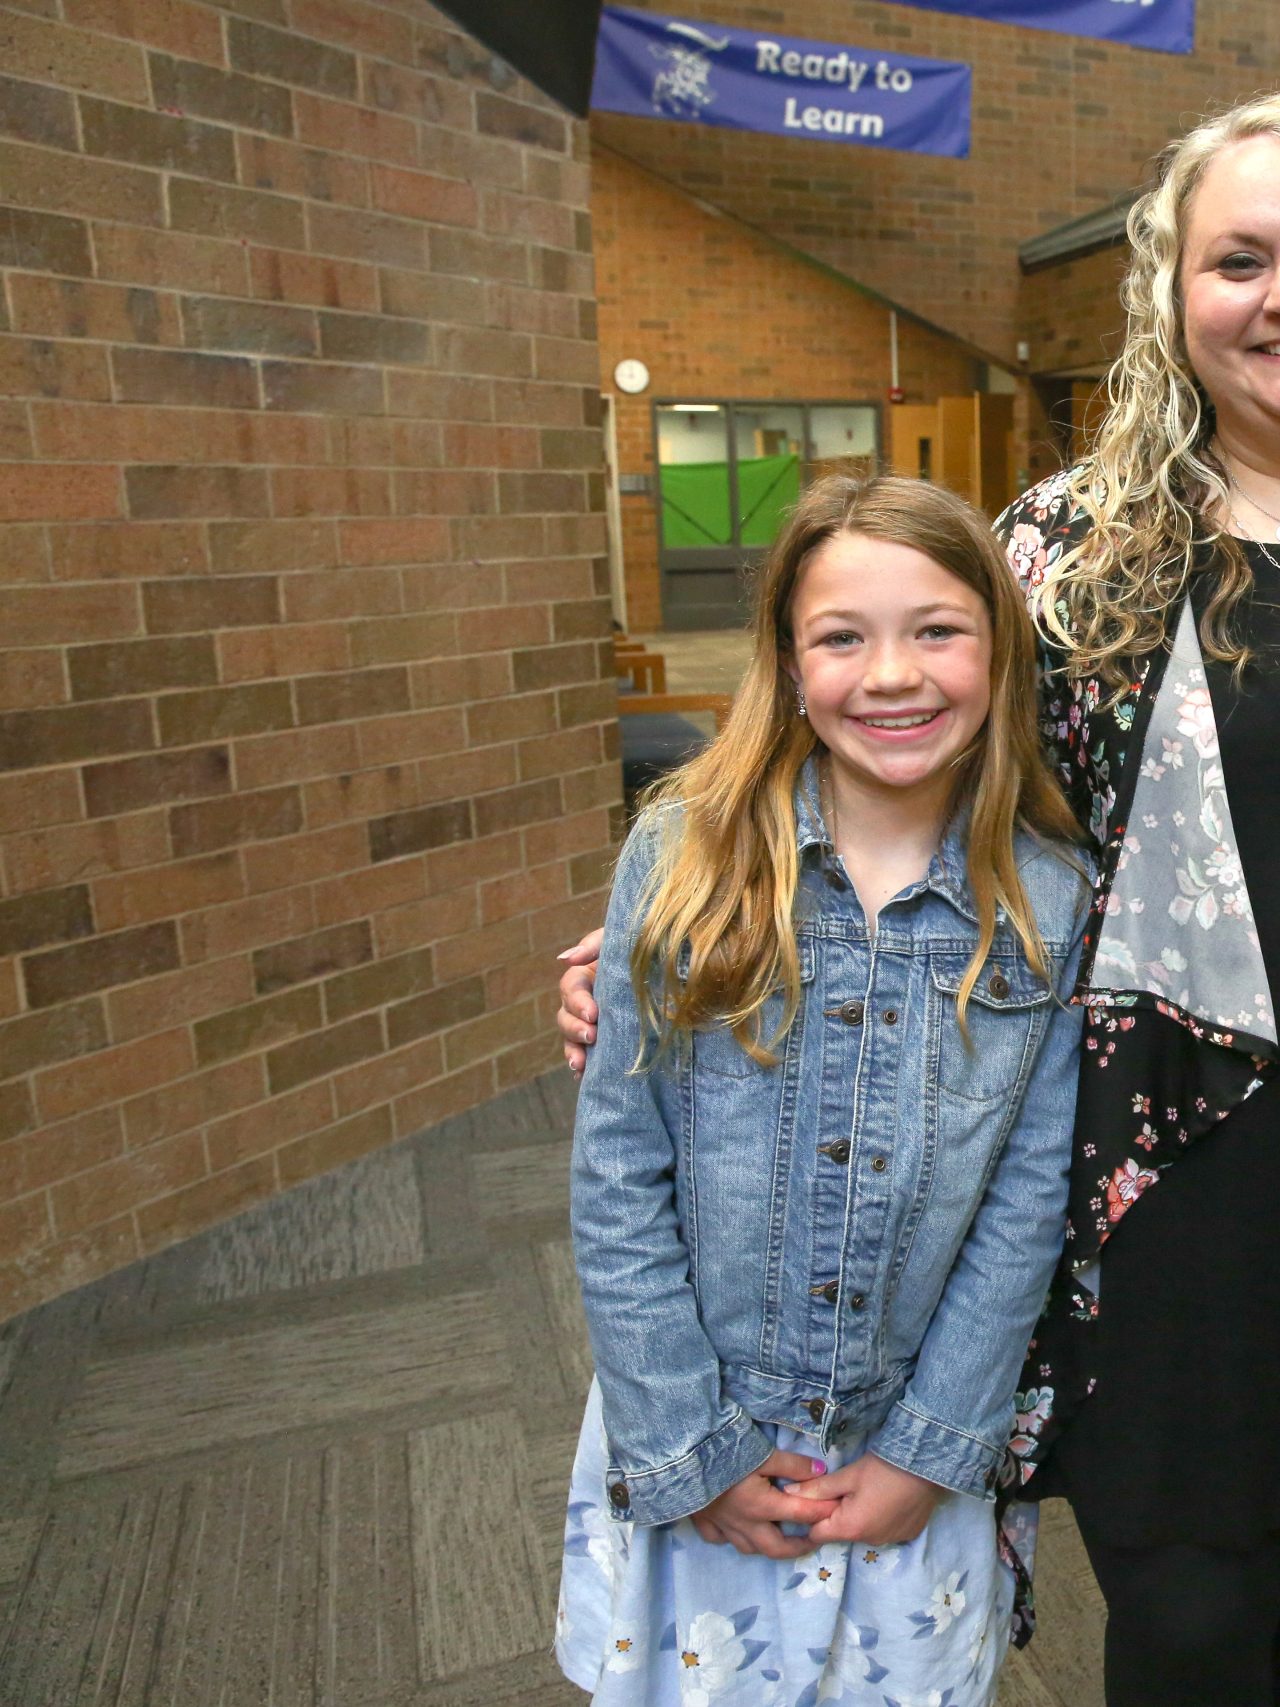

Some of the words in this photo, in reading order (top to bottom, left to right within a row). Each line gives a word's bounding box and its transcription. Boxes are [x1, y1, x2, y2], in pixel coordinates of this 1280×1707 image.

[755, 40, 869, 93] Ready
[875, 60, 913, 93] to
[784, 97, 884, 138] Learn
